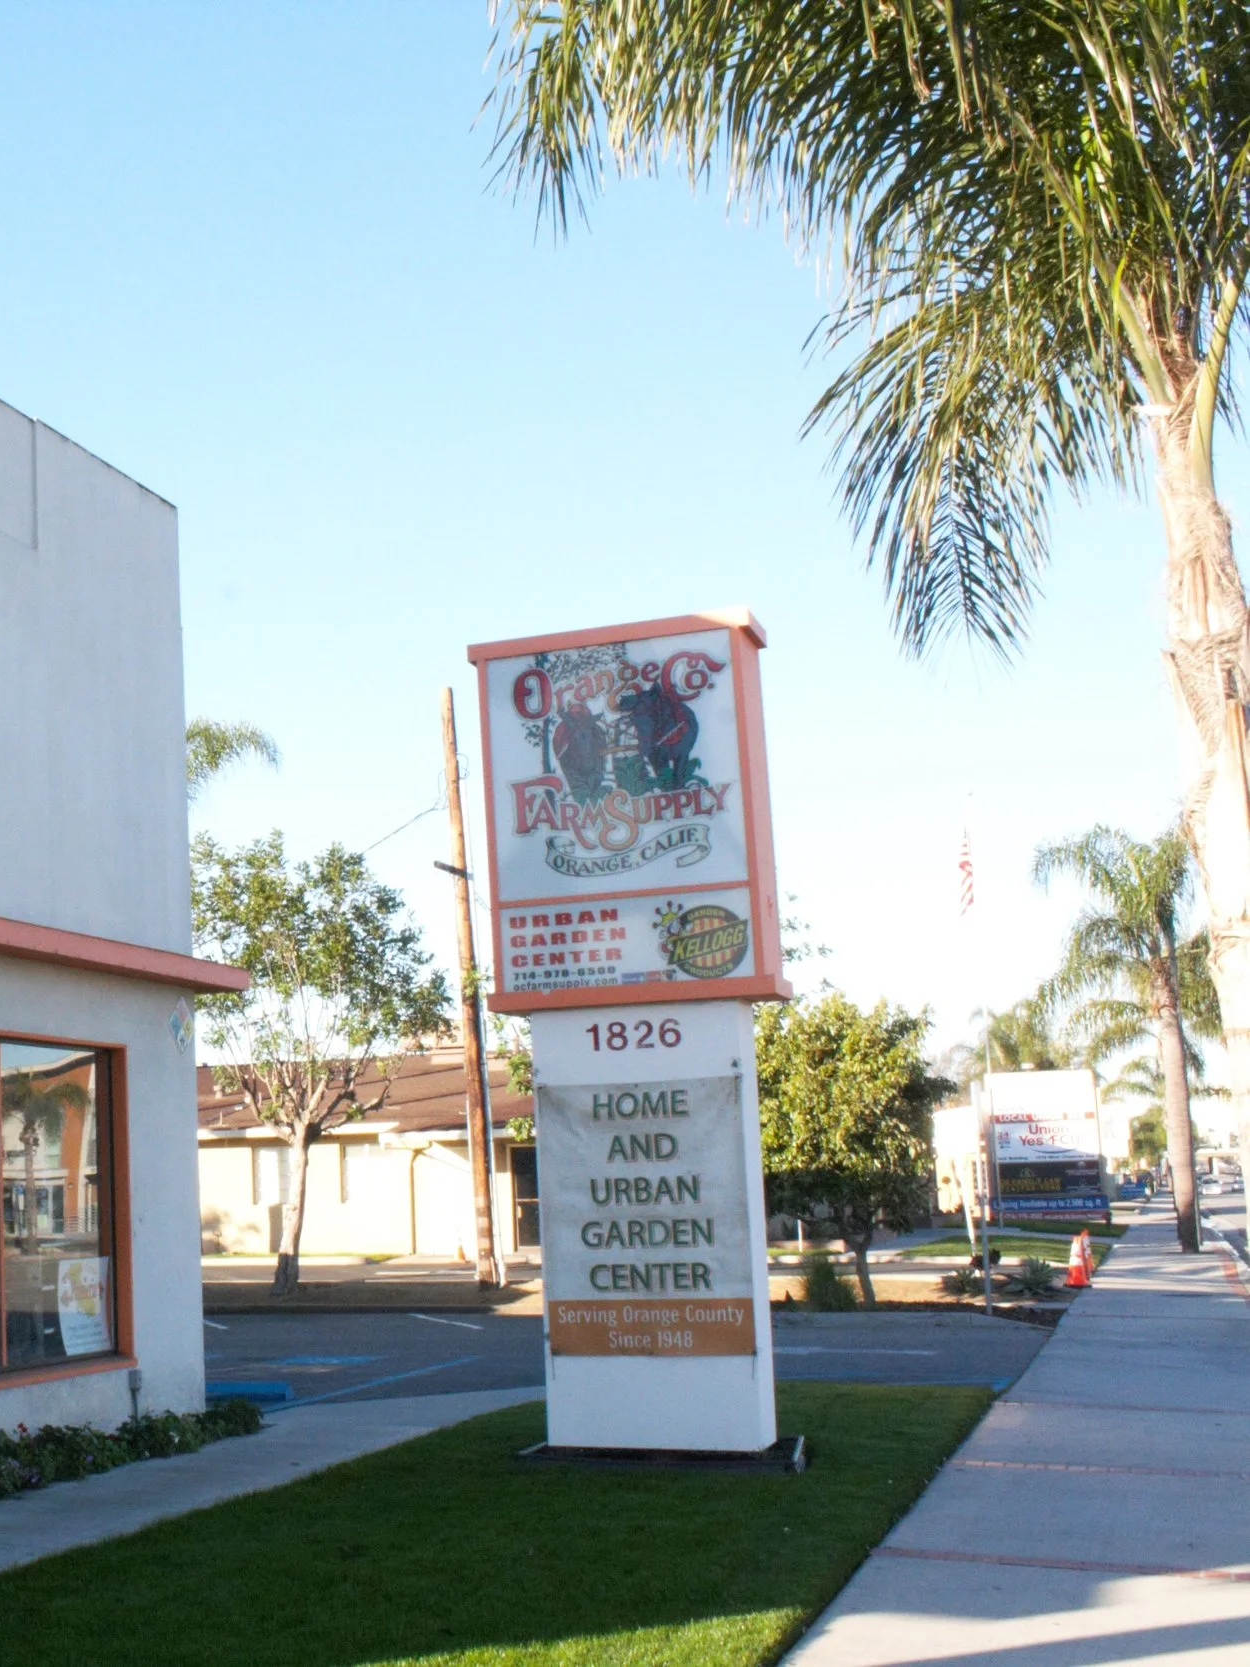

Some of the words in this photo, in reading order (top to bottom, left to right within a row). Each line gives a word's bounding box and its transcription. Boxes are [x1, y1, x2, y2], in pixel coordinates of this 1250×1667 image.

[513, 658, 659, 719] Orange
[509, 908, 618, 929] URBAN
[510, 927, 626, 948] GARDEN
[673, 923, 745, 963] KELLOGG
[511, 948, 622, 968] CENTER
[513, 976, 619, 992] ocfarmsupply.com
[586, 1018, 682, 1051] 1826
[592, 1090, 690, 1121] HOME
[999, 1113, 1028, 1122] LOCAL
[1029, 1123, 1069, 1135] Union
[607, 1133, 679, 1163] AND
[1019, 1136, 1044, 1146] Yes
[589, 1174, 701, 1206] URBAN
[581, 1218, 714, 1249] GARDEN
[589, 1262, 713, 1293] CENTER
[557, 1305, 617, 1327] Serving
[622, 1305, 679, 1327] Orange
[686, 1304, 744, 1327] County
[609, 1331, 651, 1348] Since
[657, 1331, 694, 1348] 1948
